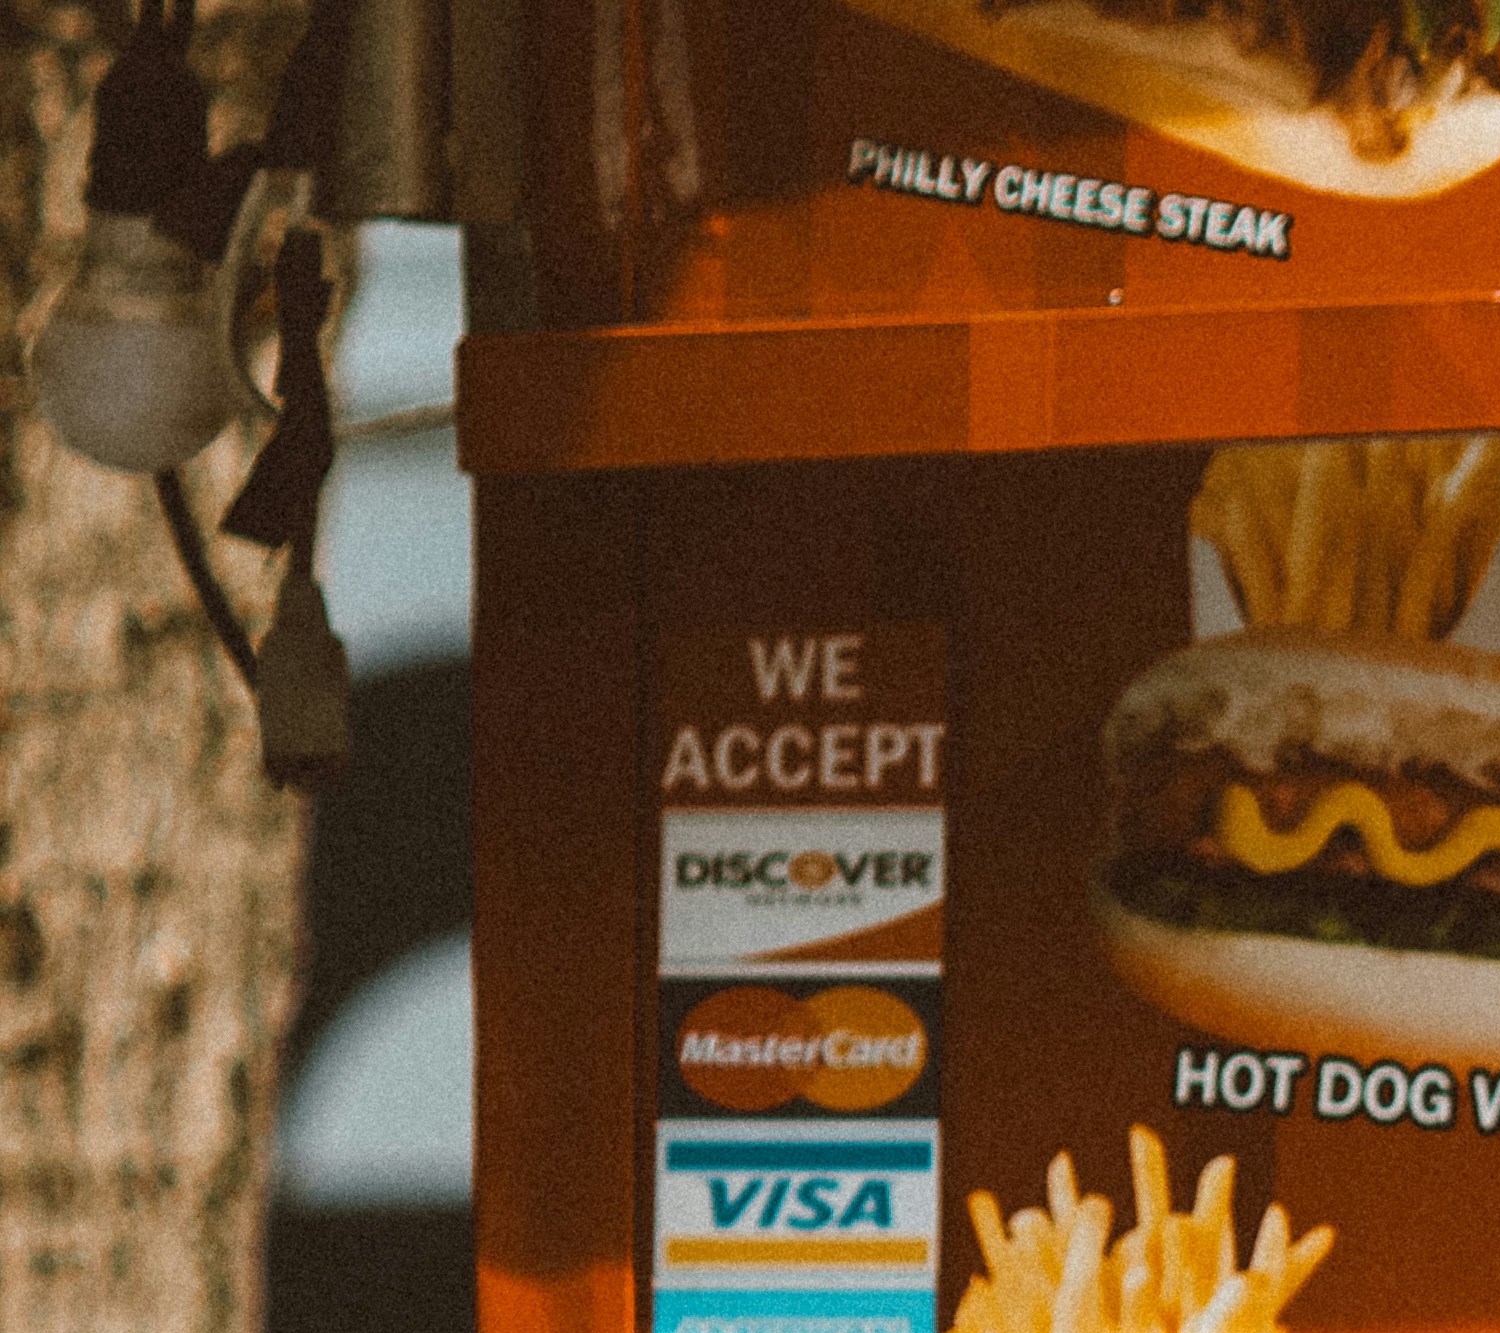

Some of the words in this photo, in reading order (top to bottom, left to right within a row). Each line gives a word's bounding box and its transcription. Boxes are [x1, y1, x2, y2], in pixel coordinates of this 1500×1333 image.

[849, 138, 991, 199] PHILLY
[995, 165, 1152, 231] CHEESE
[1157, 193, 1291, 256] STEAK
[747, 633, 865, 700] WE
[661, 722, 947, 791] ACCEPT
[674, 850, 934, 890] DISCOVER
[680, 1029, 922, 1070] MasterCard
[1174, 1049, 1303, 1112] HOT
[1317, 1061, 1452, 1127] DOG
[709, 1177, 893, 1231] VISA
